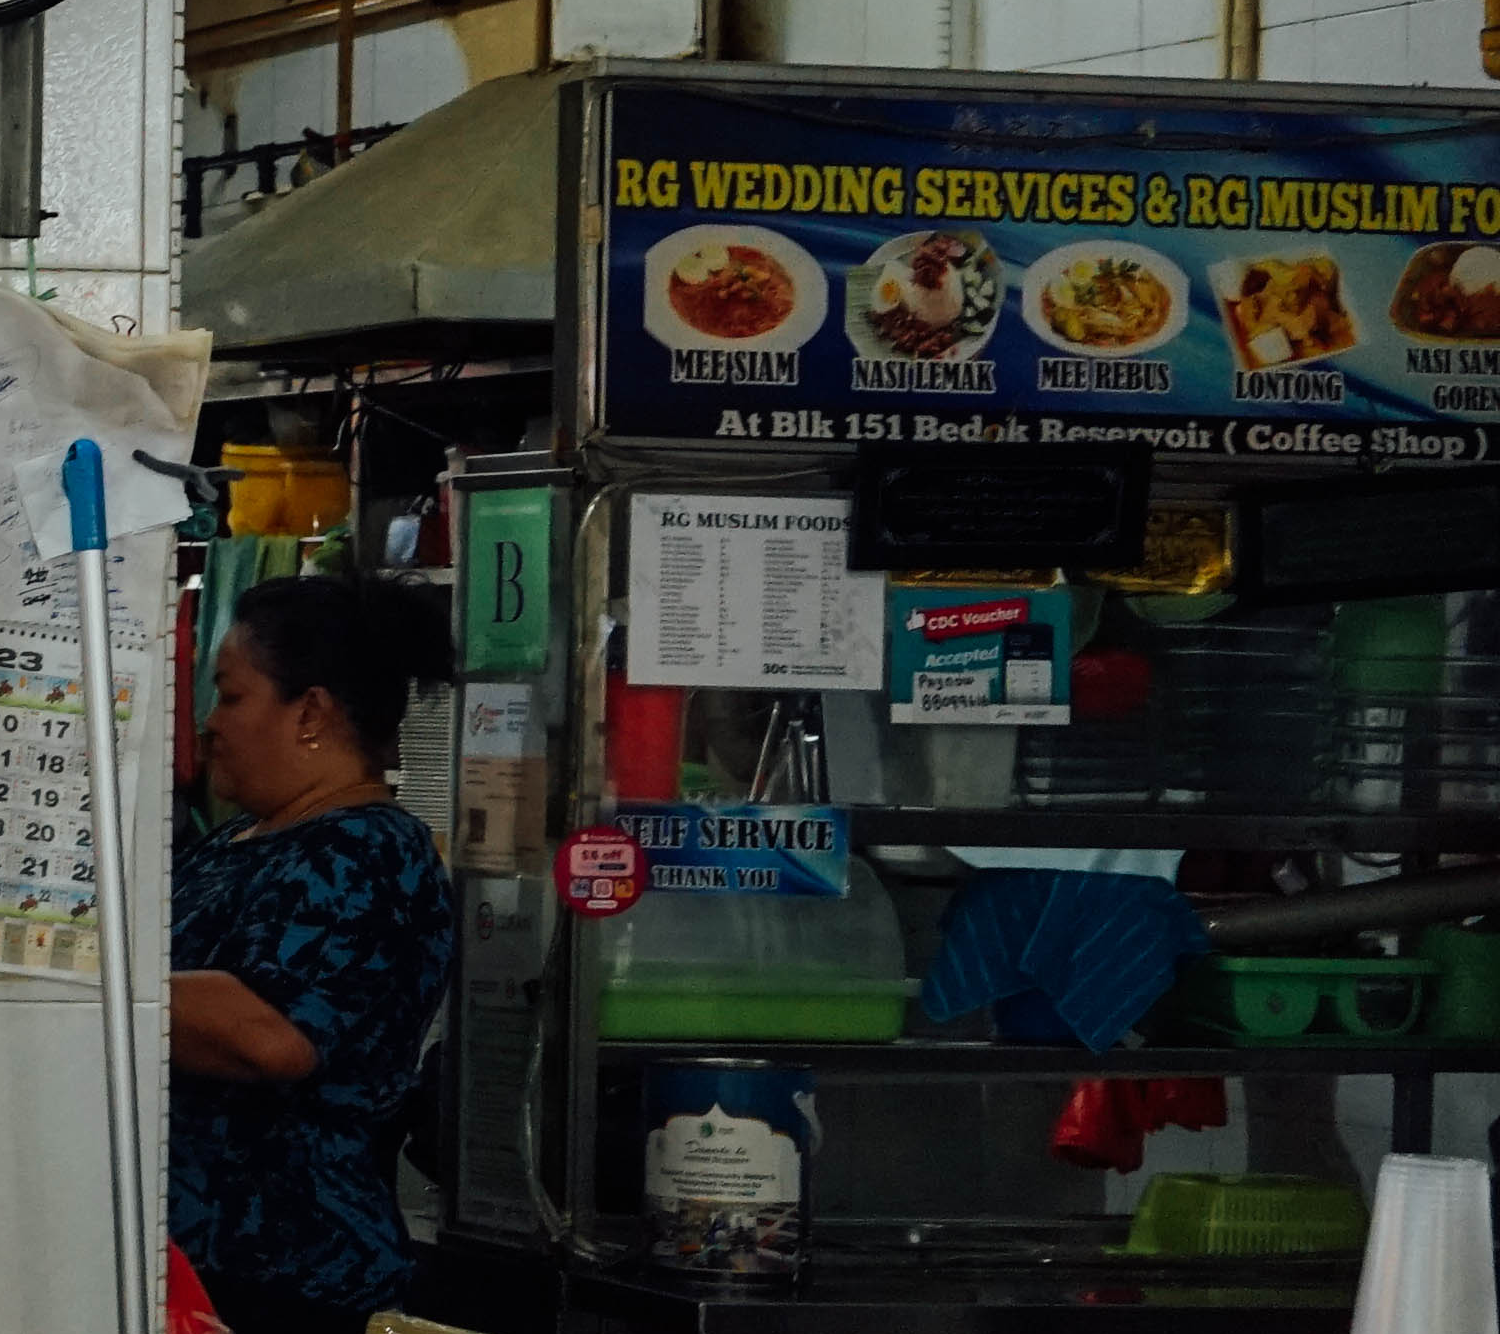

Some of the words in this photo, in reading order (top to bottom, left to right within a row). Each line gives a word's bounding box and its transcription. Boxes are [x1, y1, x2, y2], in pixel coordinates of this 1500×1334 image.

[615, 159, 679, 210] RG
[691, 161, 905, 216] WEDDING
[914, 166, 1136, 224] SERVICES
[1145, 174, 1178, 224] &
[1189, 176, 1251, 228] RG
[1260, 180, 1439, 235] MUSLIM
[672, 349, 725, 382] MEE
[732, 350, 797, 383] SIAM
[1407, 348, 1451, 375] NASI
[852, 360, 906, 391] NASI
[913, 361, 994, 392] LEMAK
[1039, 359, 1087, 390] MEE
[1096, 361, 1169, 392] REBUS
[1236, 371, 1342, 402] LONTONG
[717, 409, 763, 437] At
[773, 410, 835, 439] Blk
[845, 413, 902, 440] 151
[916, 414, 1027, 443] Bedok
[1040, 419, 1213, 450] Reservoir
[1247, 424, 1360, 453] Coffee
[1372, 428, 1464, 459] Shop
[661, 512, 690, 527] RG
[697, 513, 778, 530] MUSLIM
[492, 541, 524, 623] B
[927, 616, 959, 630] CDC
[962, 608, 1021, 625] Voucher
[925, 645, 1000, 667] Accepted
[42, 719, 70, 739] 17
[36, 754, 65, 774] 18
[31, 788, 59, 807] 19
[24, 822, 55, 843] 20
[700, 818, 835, 850] SERVICE
[19, 857, 49, 877] 21
[653, 867, 727, 889] THANK
[735, 868, 779, 889] YOU
